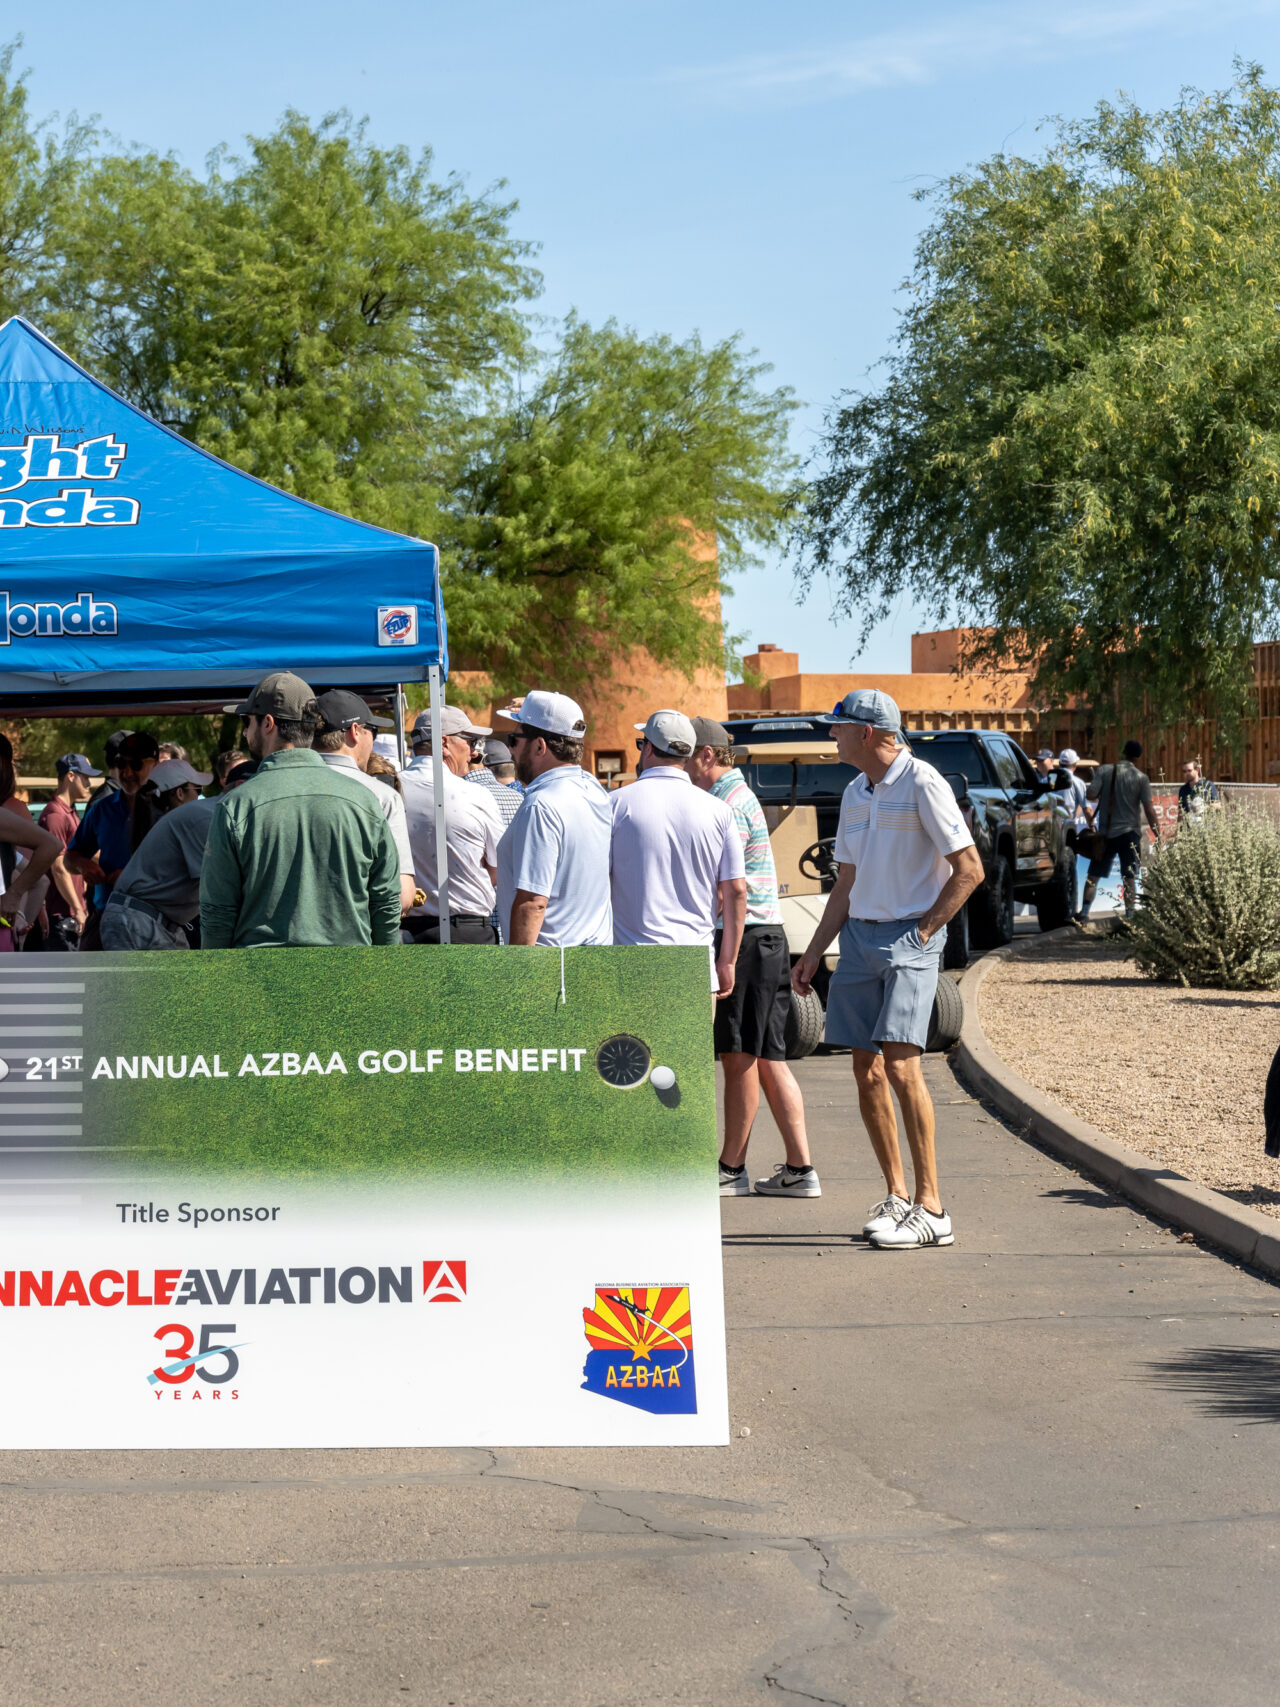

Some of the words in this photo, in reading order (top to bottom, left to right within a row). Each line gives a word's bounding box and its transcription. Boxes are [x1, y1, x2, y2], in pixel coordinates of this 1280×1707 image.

[25, 1055, 83, 1080] 21ST
[91, 1054, 229, 1080] ANNUAL
[238, 1051, 349, 1077] AZBAA
[357, 1049, 444, 1074] GOLF
[454, 1048, 587, 1073] BENEFIT
[116, 1202, 170, 1223] Title
[177, 1202, 281, 1229] Sponsor
[152, 1323, 240, 1385] 35
[605, 1365, 681, 1388] AZBAA
[154, 1390, 240, 1401] YEARS
